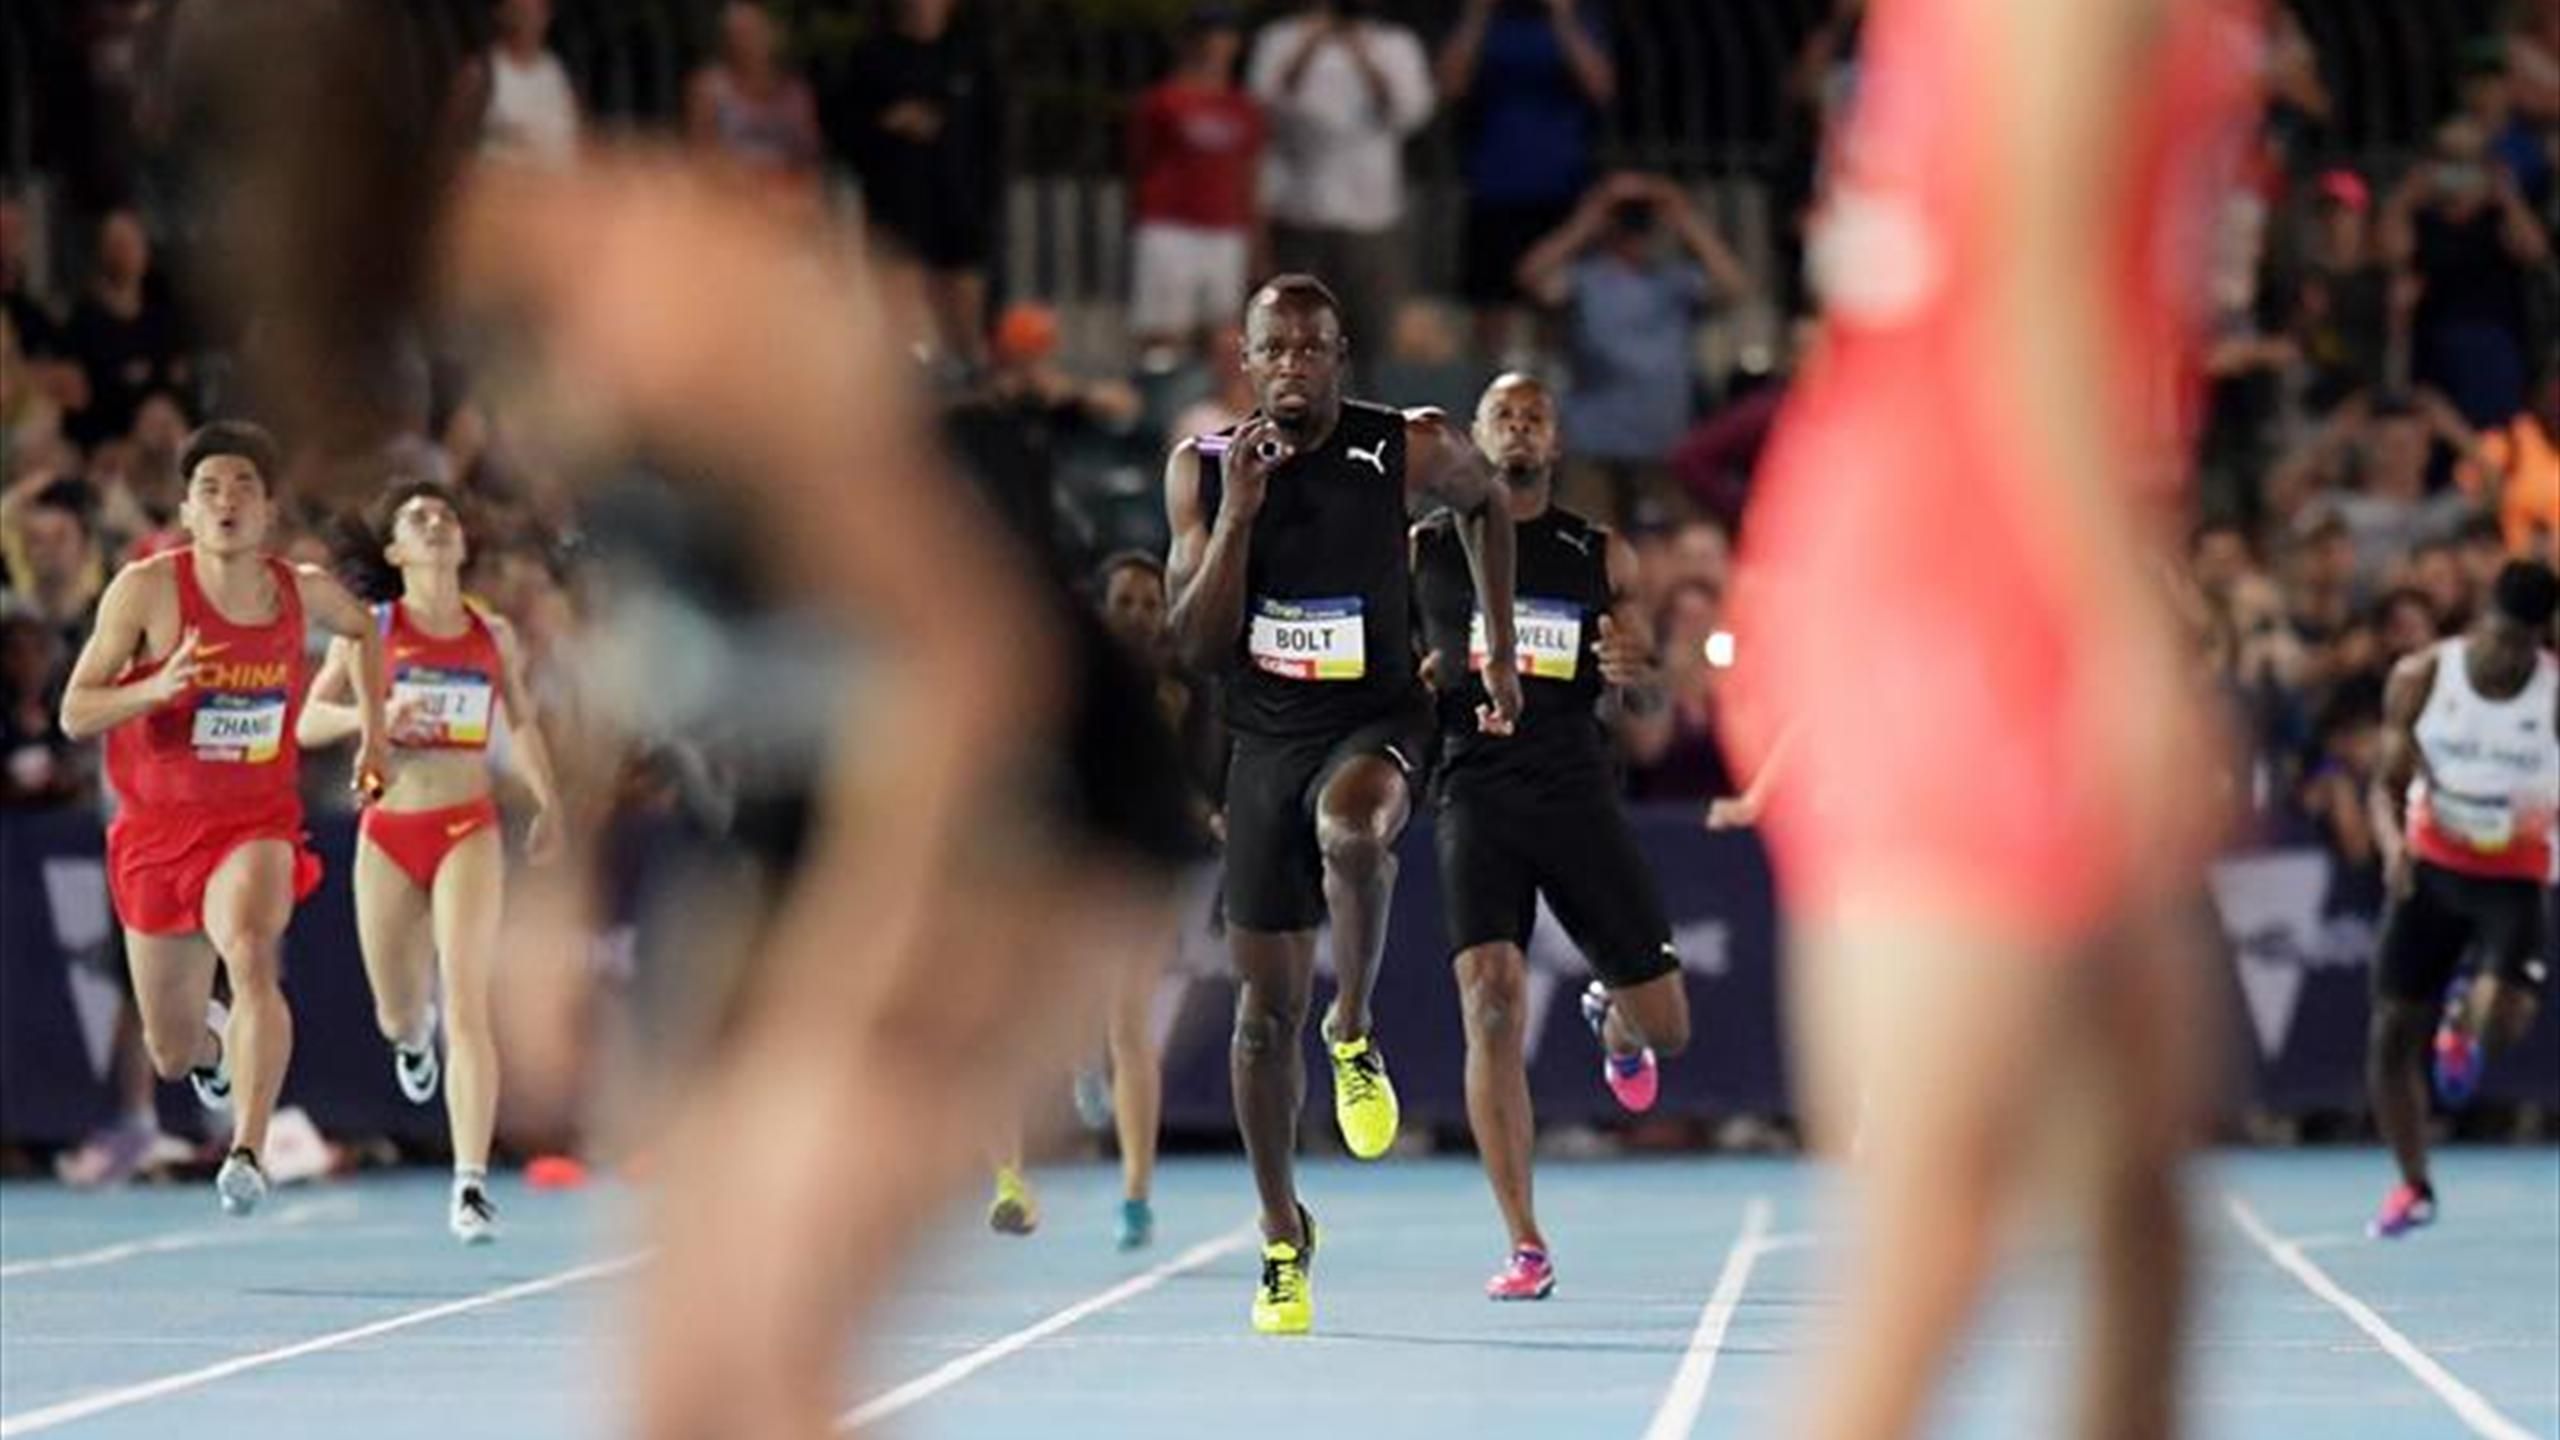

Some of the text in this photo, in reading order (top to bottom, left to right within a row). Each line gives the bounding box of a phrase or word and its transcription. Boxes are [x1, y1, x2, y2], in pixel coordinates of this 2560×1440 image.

[1276, 627, 1335, 651] BOLT
[1515, 625, 1568, 651] WELL
[195, 662, 287, 688] CHINA
